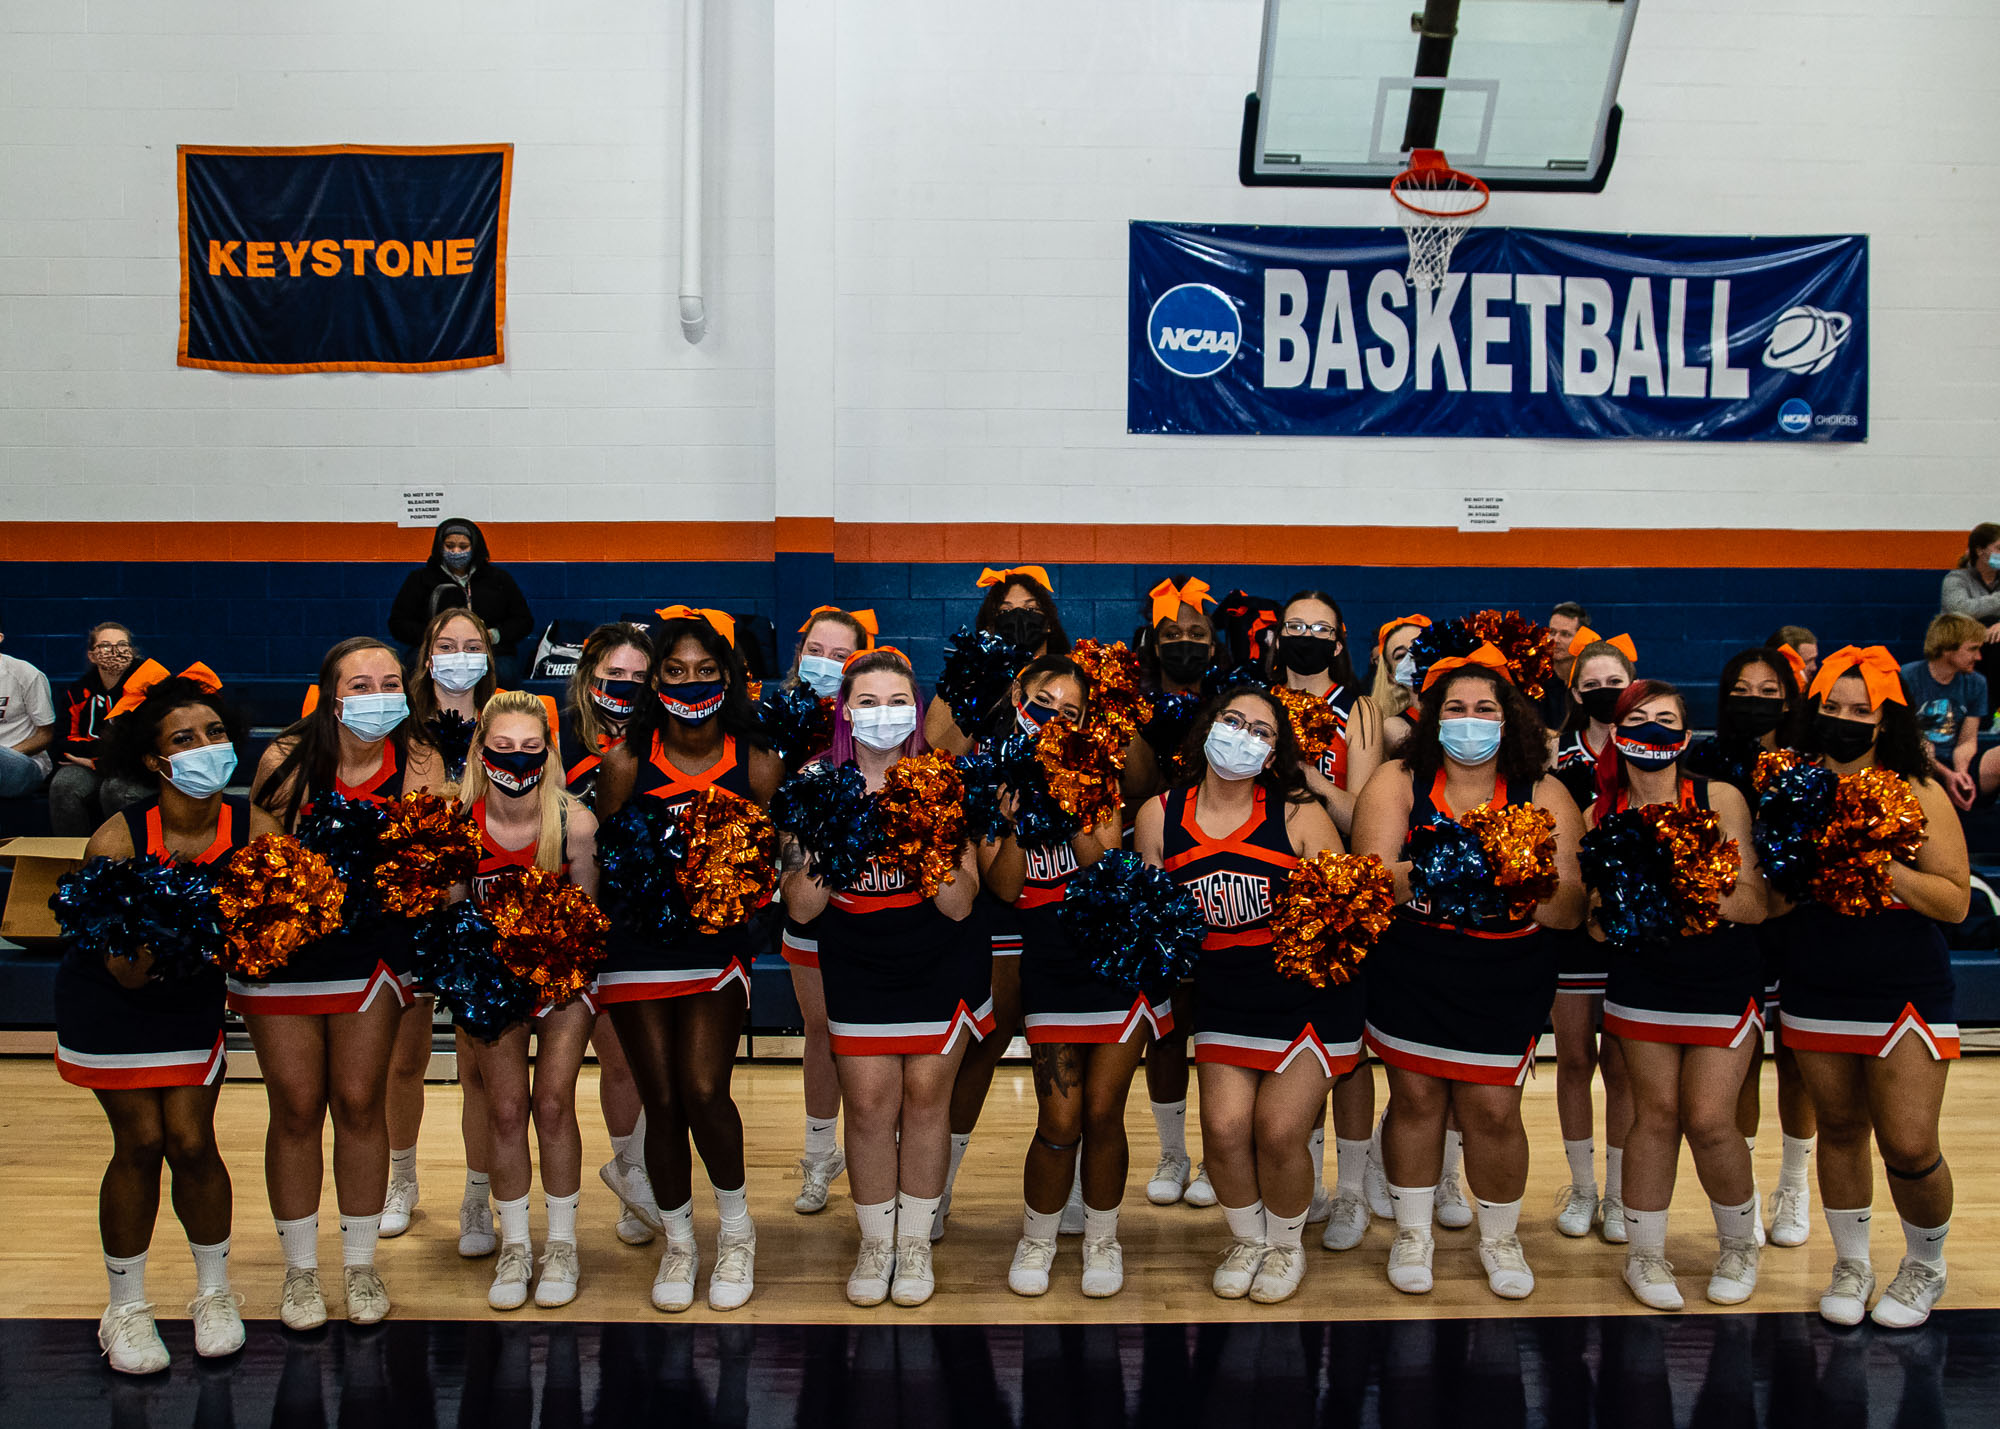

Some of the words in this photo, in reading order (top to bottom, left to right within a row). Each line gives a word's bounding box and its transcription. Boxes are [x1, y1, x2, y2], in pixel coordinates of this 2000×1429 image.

[208, 238, 476, 278] KEYSTONE
[1158, 326, 1236, 354] NCAA
[1263, 268, 1750, 399] BASKETBALL
[1814, 415, 1859, 426] CHOICES
[546, 663, 578, 676] CHEER
[671, 701, 690, 715] KC
[1624, 741, 1647, 755] KC
[492, 769, 515, 785] KC
[1184, 871, 1272, 927] EYSTONE
